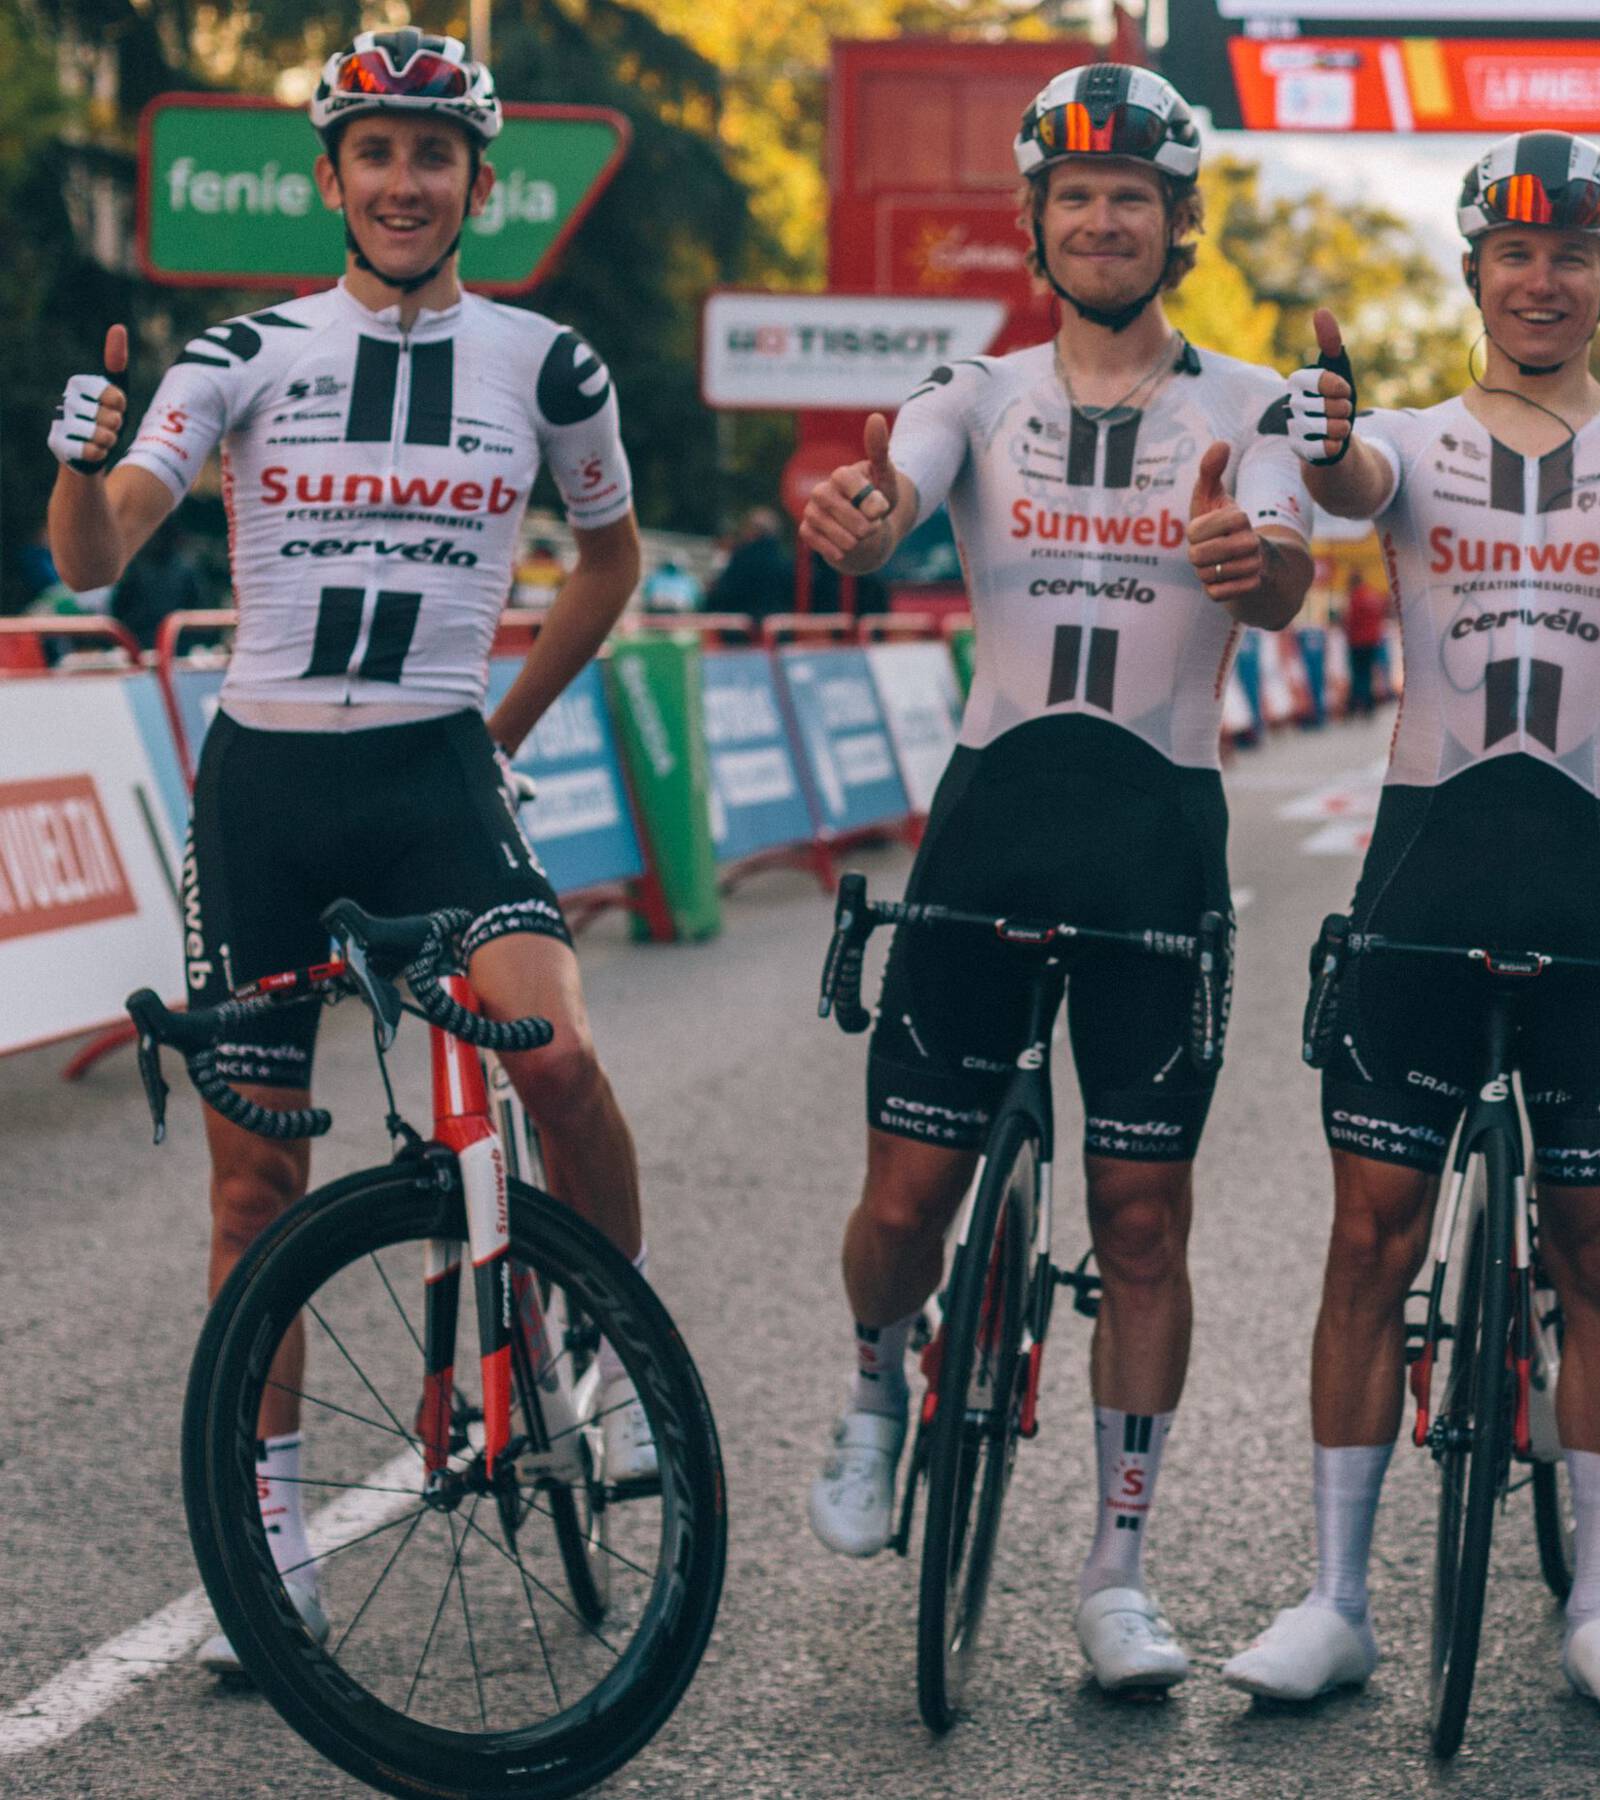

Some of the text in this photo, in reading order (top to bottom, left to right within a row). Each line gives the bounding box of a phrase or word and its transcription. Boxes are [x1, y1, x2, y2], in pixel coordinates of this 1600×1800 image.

[260, 466, 518, 514] Sunweb
[1011, 500, 1185, 548] Sunweb
[279, 537, 478, 567] cervélo
[1029, 577, 1156, 605] cervélo
[1451, 608, 1600, 642] cervélo
